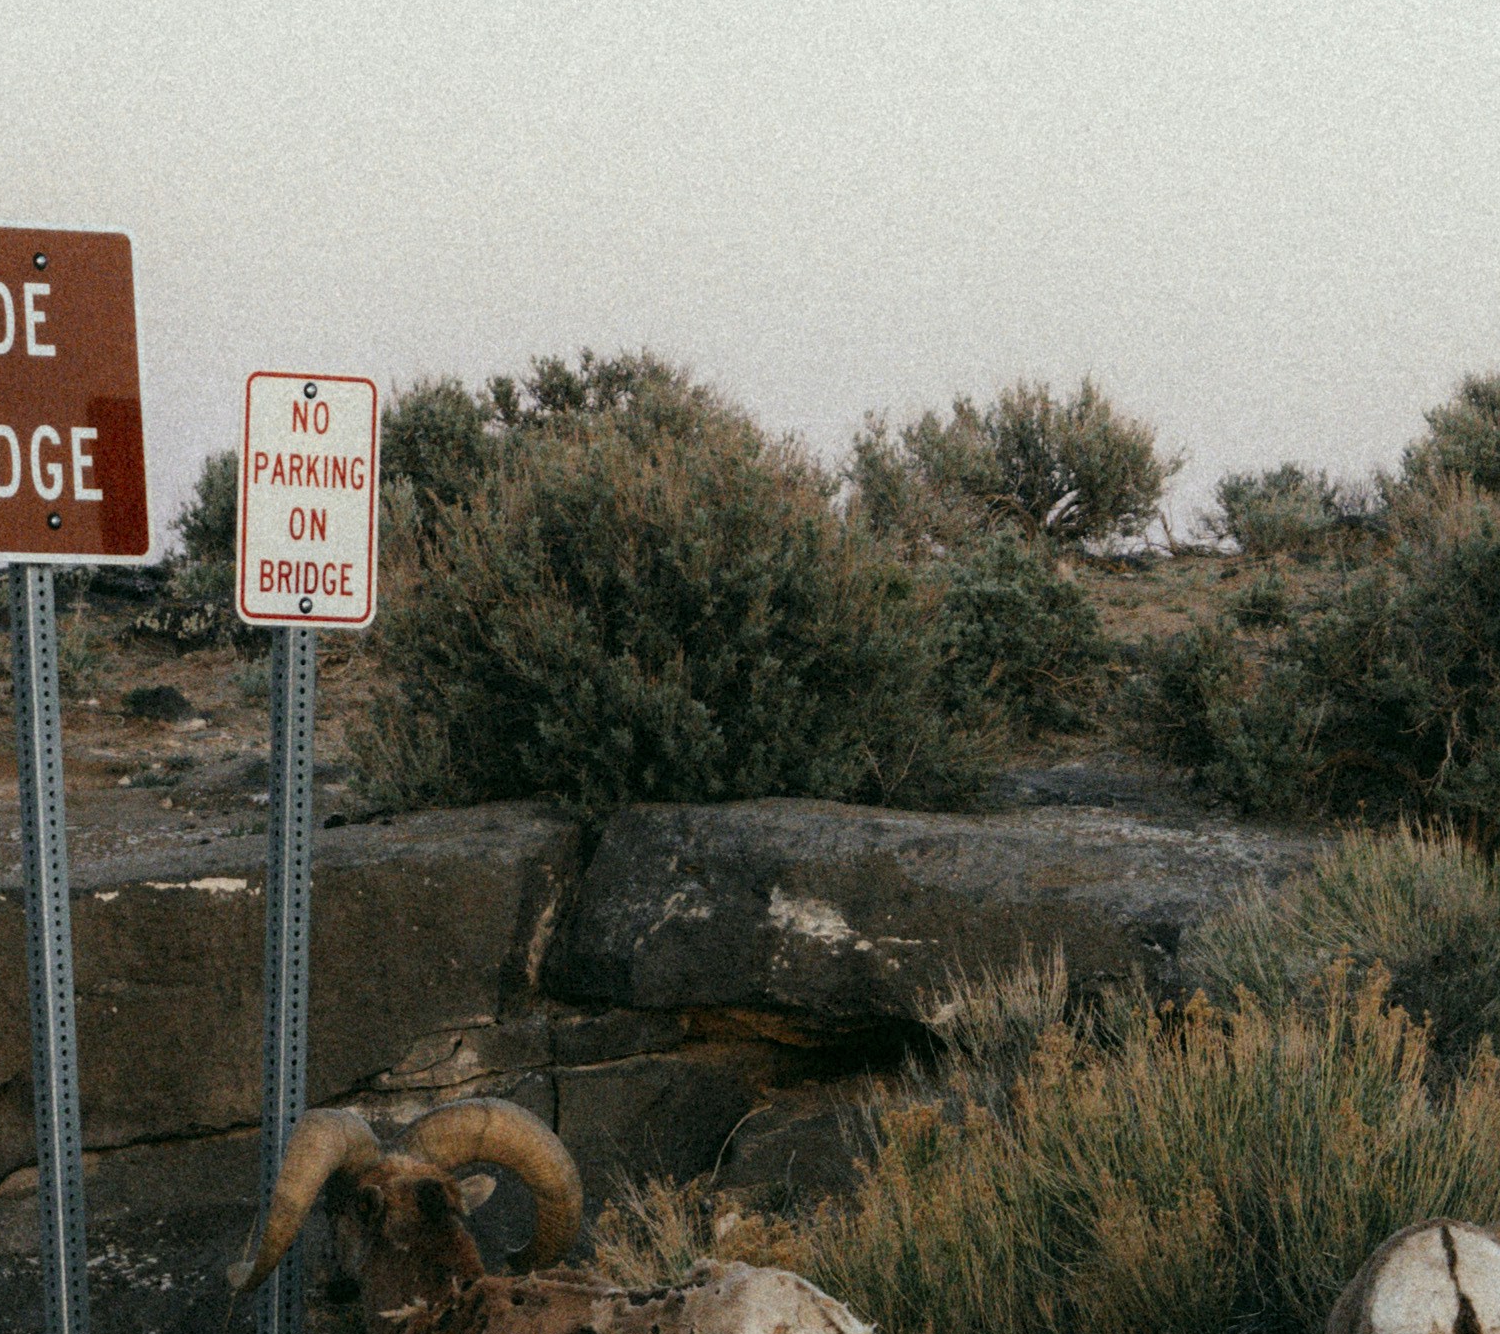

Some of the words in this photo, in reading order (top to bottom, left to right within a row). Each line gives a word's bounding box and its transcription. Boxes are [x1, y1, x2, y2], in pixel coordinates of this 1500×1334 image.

[292, 400, 329, 434] NO
[253, 451, 364, 490] PARKING
[289, 507, 326, 541] ON
[259, 559, 353, 596] BRIDGE
